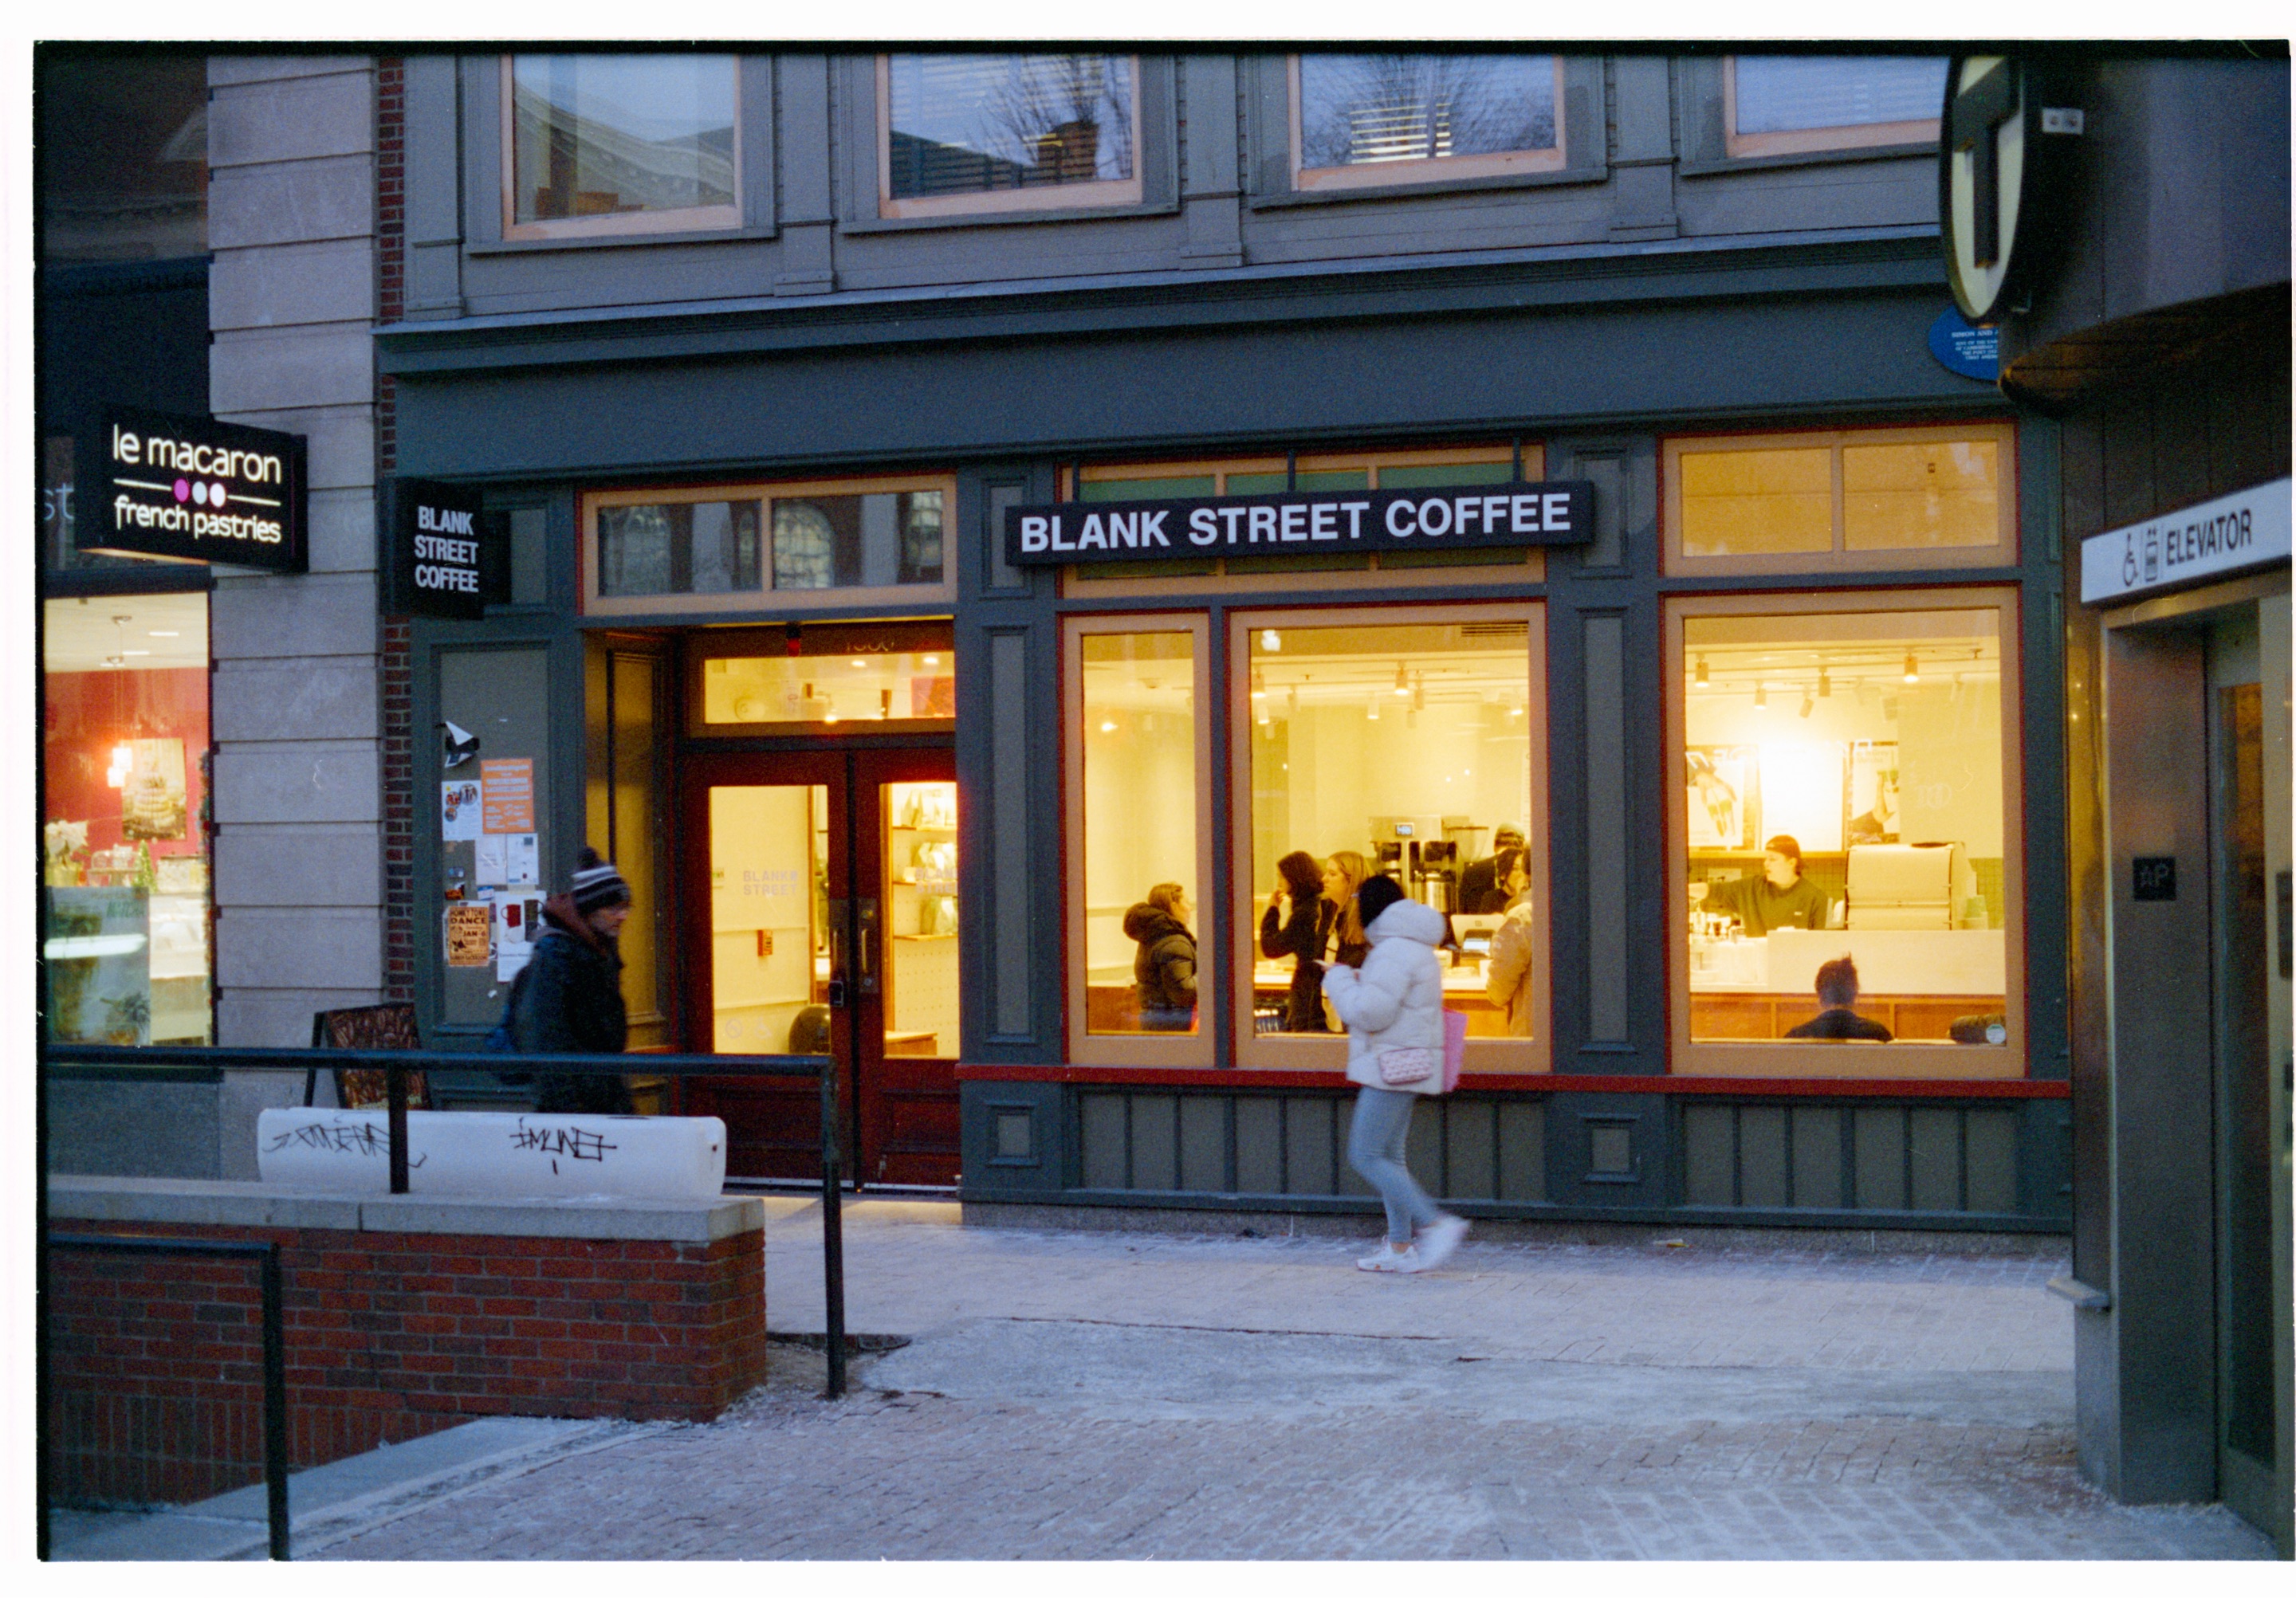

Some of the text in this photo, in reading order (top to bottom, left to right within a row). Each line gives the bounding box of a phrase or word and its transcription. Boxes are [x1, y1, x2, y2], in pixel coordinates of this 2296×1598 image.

[113, 423, 281, 484] le macaron
[114, 496, 281, 544] french pastries
[418, 505, 474, 536] BLANK
[1021, 493, 1571, 553] BLANK STREET COFFEE
[2166, 508, 2252, 566] ELEVATOR
[414, 536, 478, 564] STREET
[415, 565, 478, 593] COFFEE
[743, 883, 798, 896] STREET
